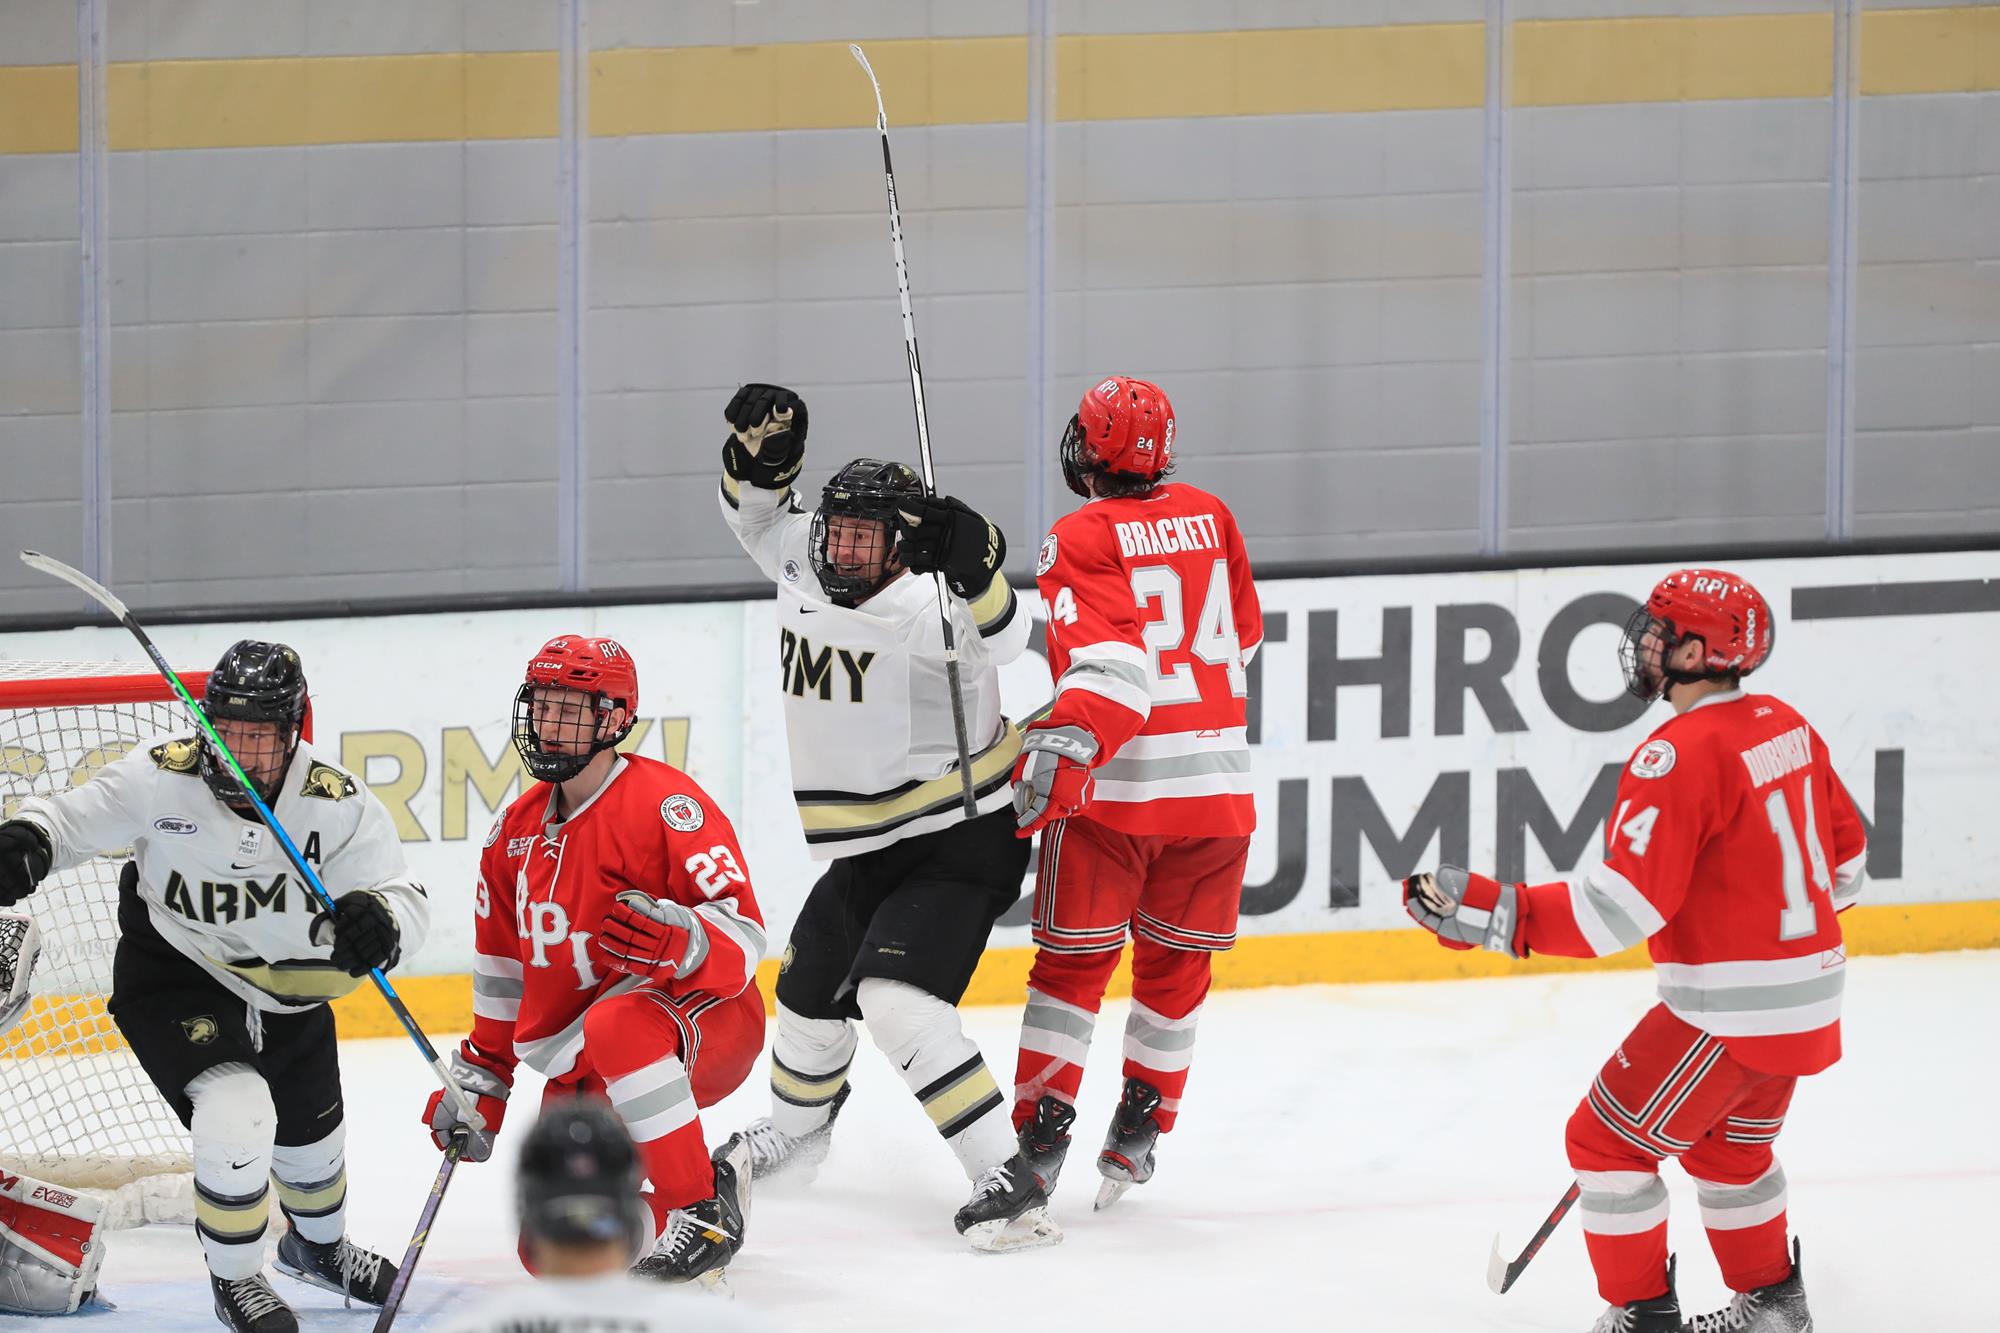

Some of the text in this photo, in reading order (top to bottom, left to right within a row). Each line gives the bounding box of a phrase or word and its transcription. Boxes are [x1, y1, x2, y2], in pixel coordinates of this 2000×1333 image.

[1097, 380, 1119, 399] RPI
[1137, 437, 1154, 450] 24
[1115, 514, 1220, 558] BRACKETT
[1692, 576, 1730, 600] RPI
[1130, 559, 1246, 704] 24
[600, 641, 625, 659] RPI
[780, 626, 876, 703] RMY
[1022, 734, 1093, 758] CCM
[241, 839, 259, 849] WEST
[1610, 799, 1660, 857] 14
[238, 847, 257, 856] POINT
[302, 831, 321, 865] A
[1765, 774, 1835, 941] 14
[685, 845, 747, 900] 23
[516, 870, 600, 992] RPI
